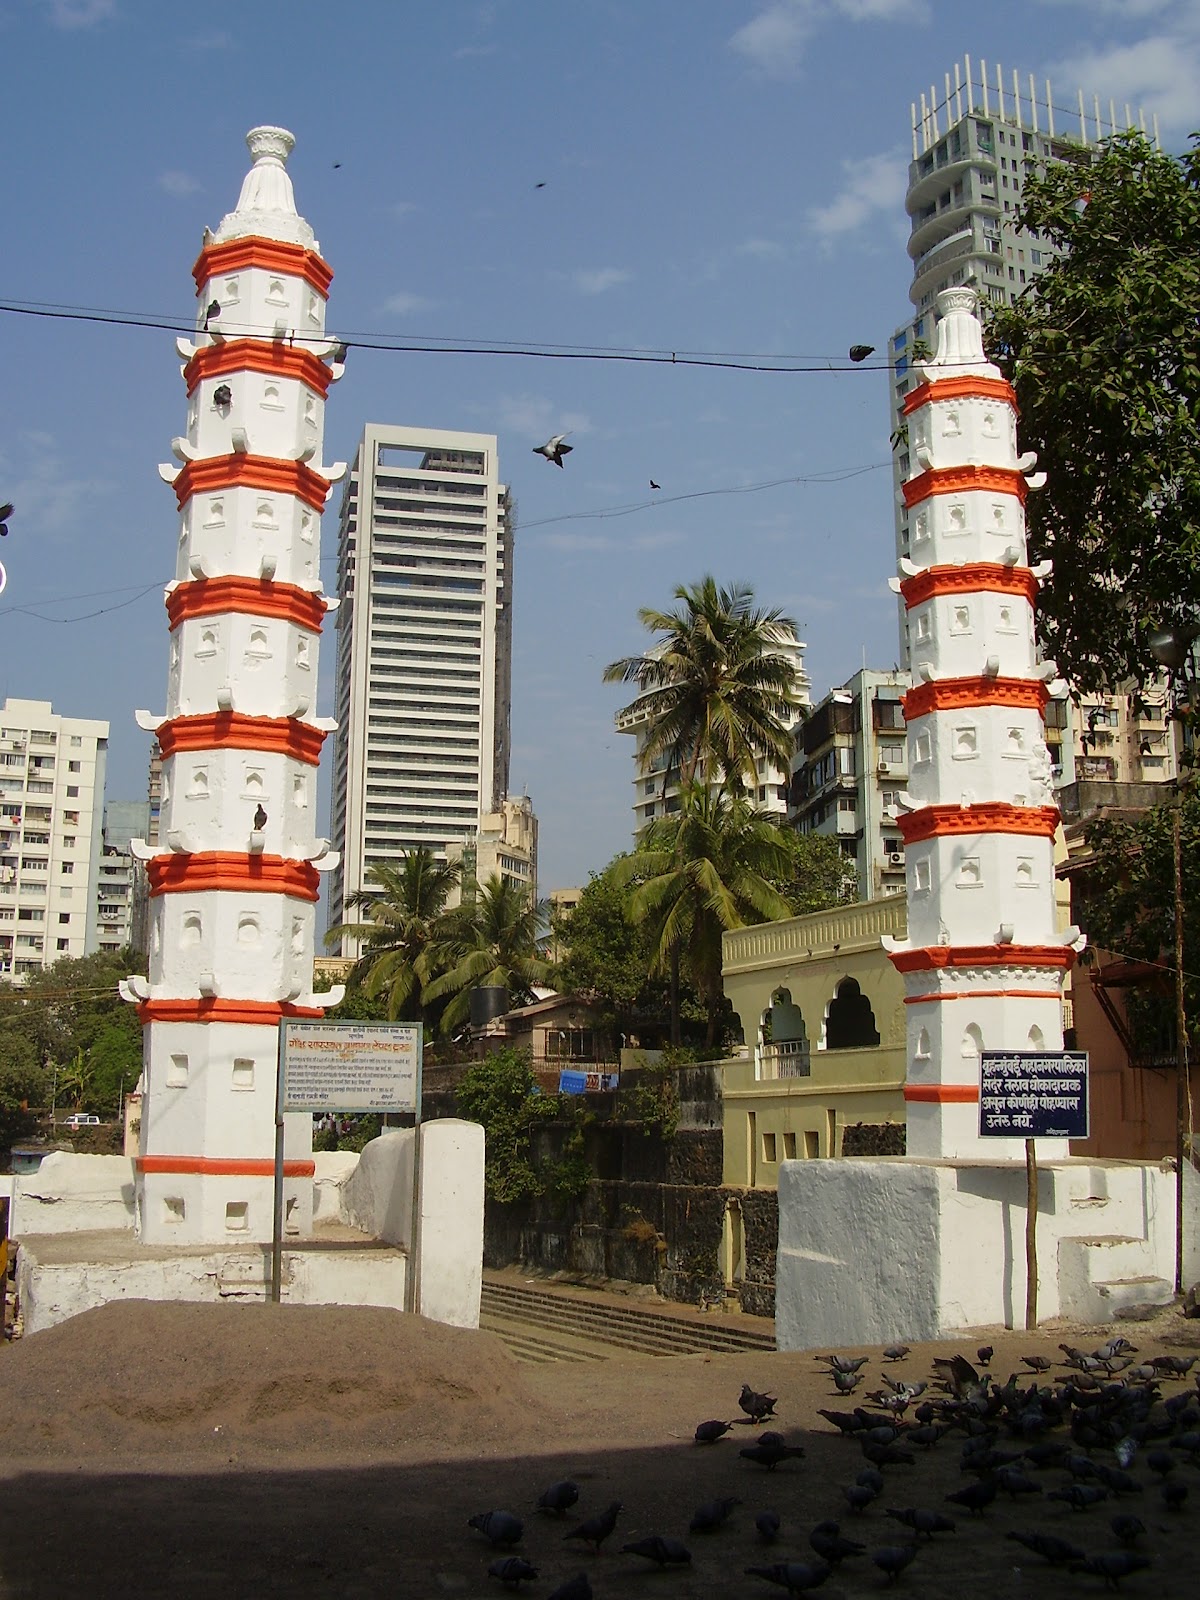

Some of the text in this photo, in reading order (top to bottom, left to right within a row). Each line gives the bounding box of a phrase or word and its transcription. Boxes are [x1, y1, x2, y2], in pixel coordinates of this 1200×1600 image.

[1020, 1055, 1086, 1076] महानगरपालिका
[1004, 1079, 1030, 1093] तलाव
[1029, 1075, 1081, 1094] धोकादायक
